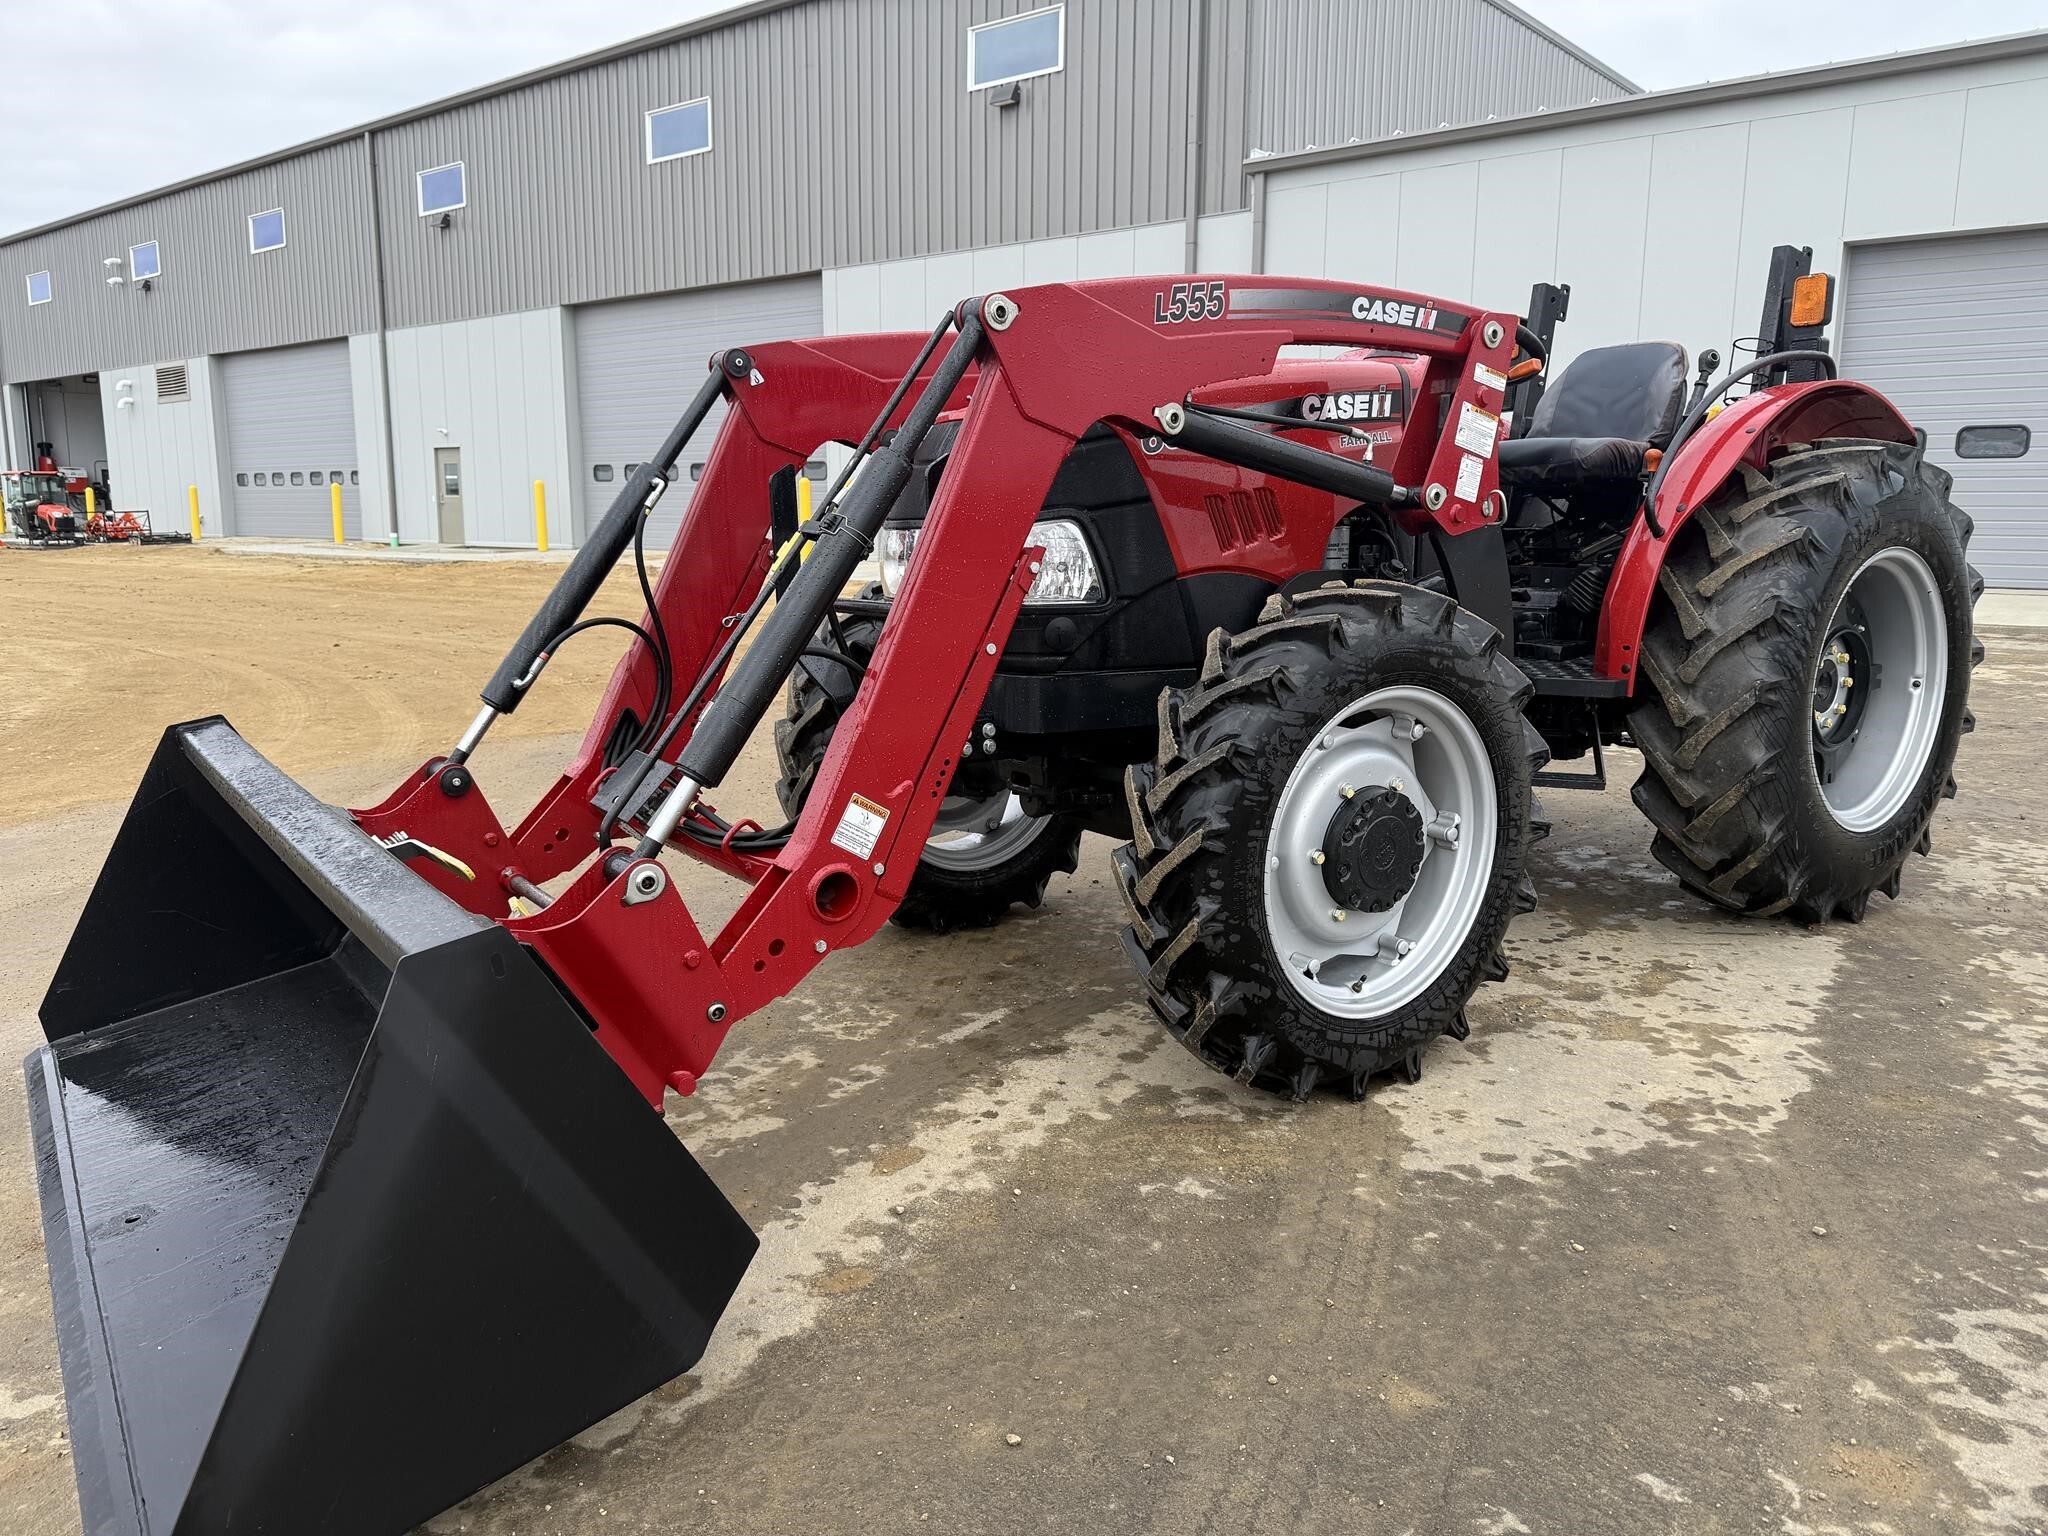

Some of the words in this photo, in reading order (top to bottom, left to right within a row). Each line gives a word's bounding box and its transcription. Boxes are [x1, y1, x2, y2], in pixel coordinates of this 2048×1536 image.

[1154, 281, 1225, 324] L555
[1352, 296, 1416, 326] CASE
[1301, 393, 1370, 420] CASE
[859, 800, 887, 818] WARNING
